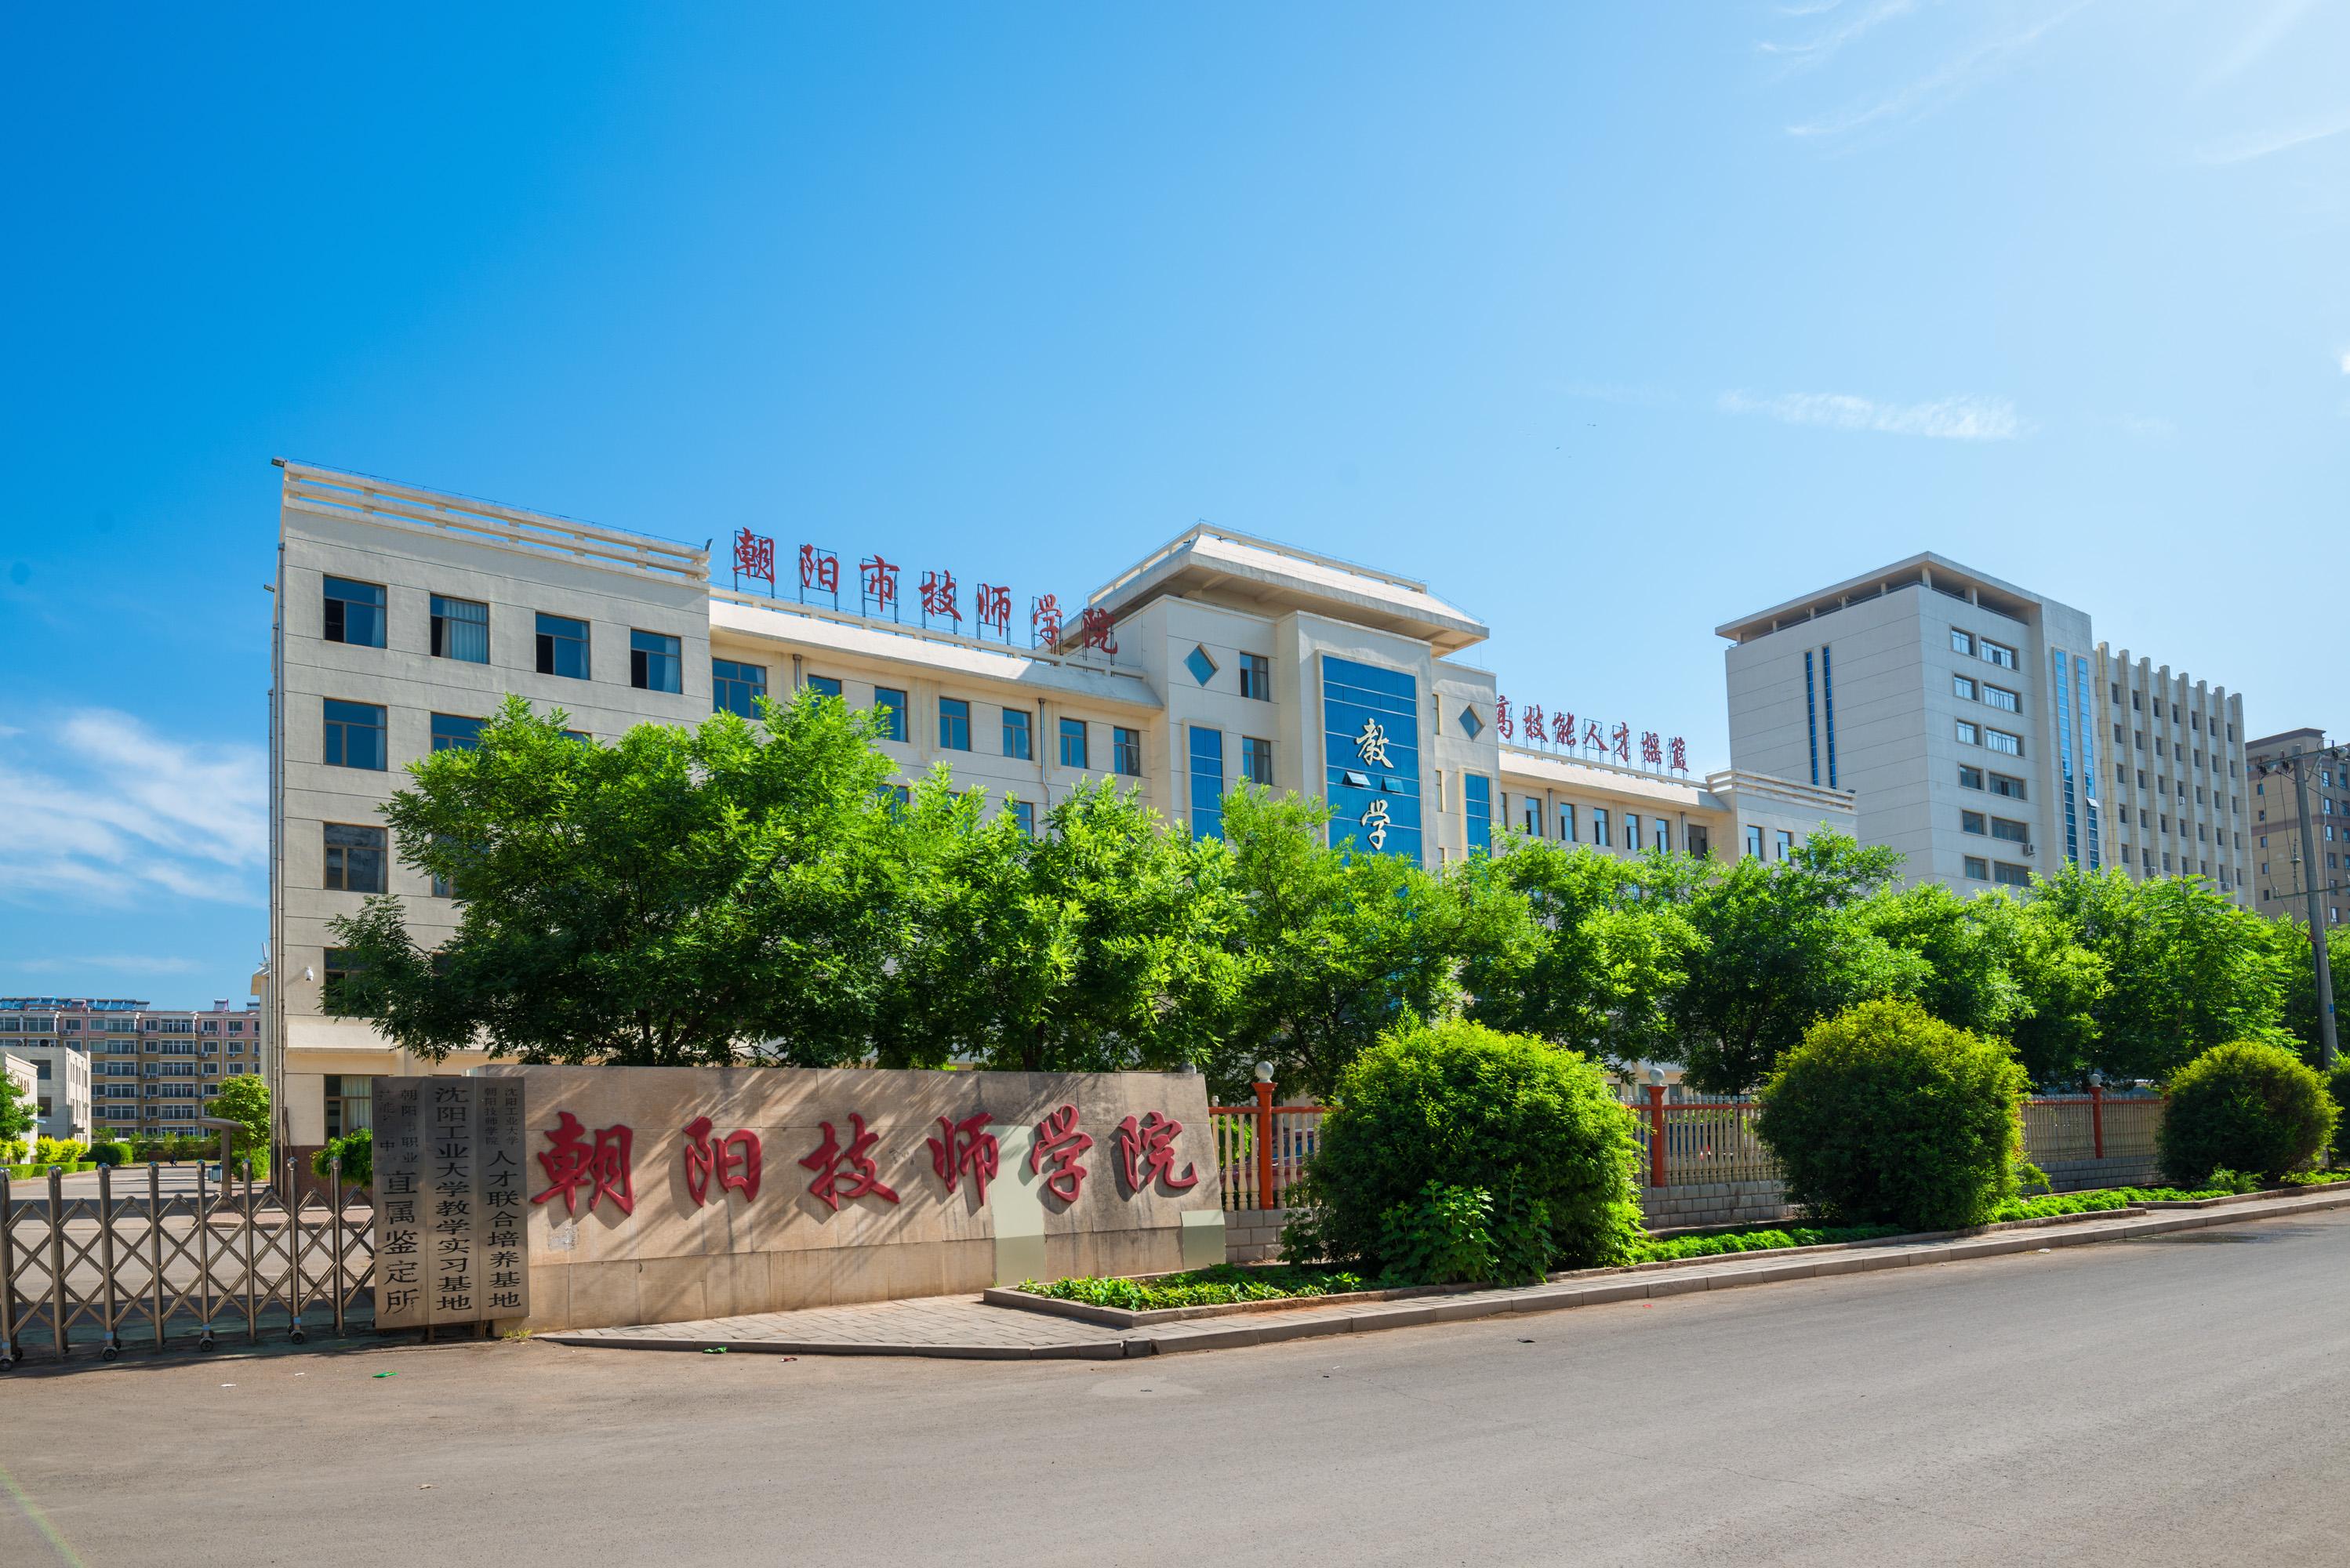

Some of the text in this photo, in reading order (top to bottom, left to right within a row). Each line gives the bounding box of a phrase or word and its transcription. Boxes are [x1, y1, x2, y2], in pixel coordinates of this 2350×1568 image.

[732, 527, 1118, 654] 朝阳市技师学院
[1355, 717, 1394, 851] 教学
[504, 1087, 519, 1145] 沈阳工业大学
[530, 1104, 1199, 1216] 朝阳技师学院
[435, 1087, 473, 1311] 沈阳工业大学教学实习基地
[486, 1150, 521, 1308] 人才联合培养基地
